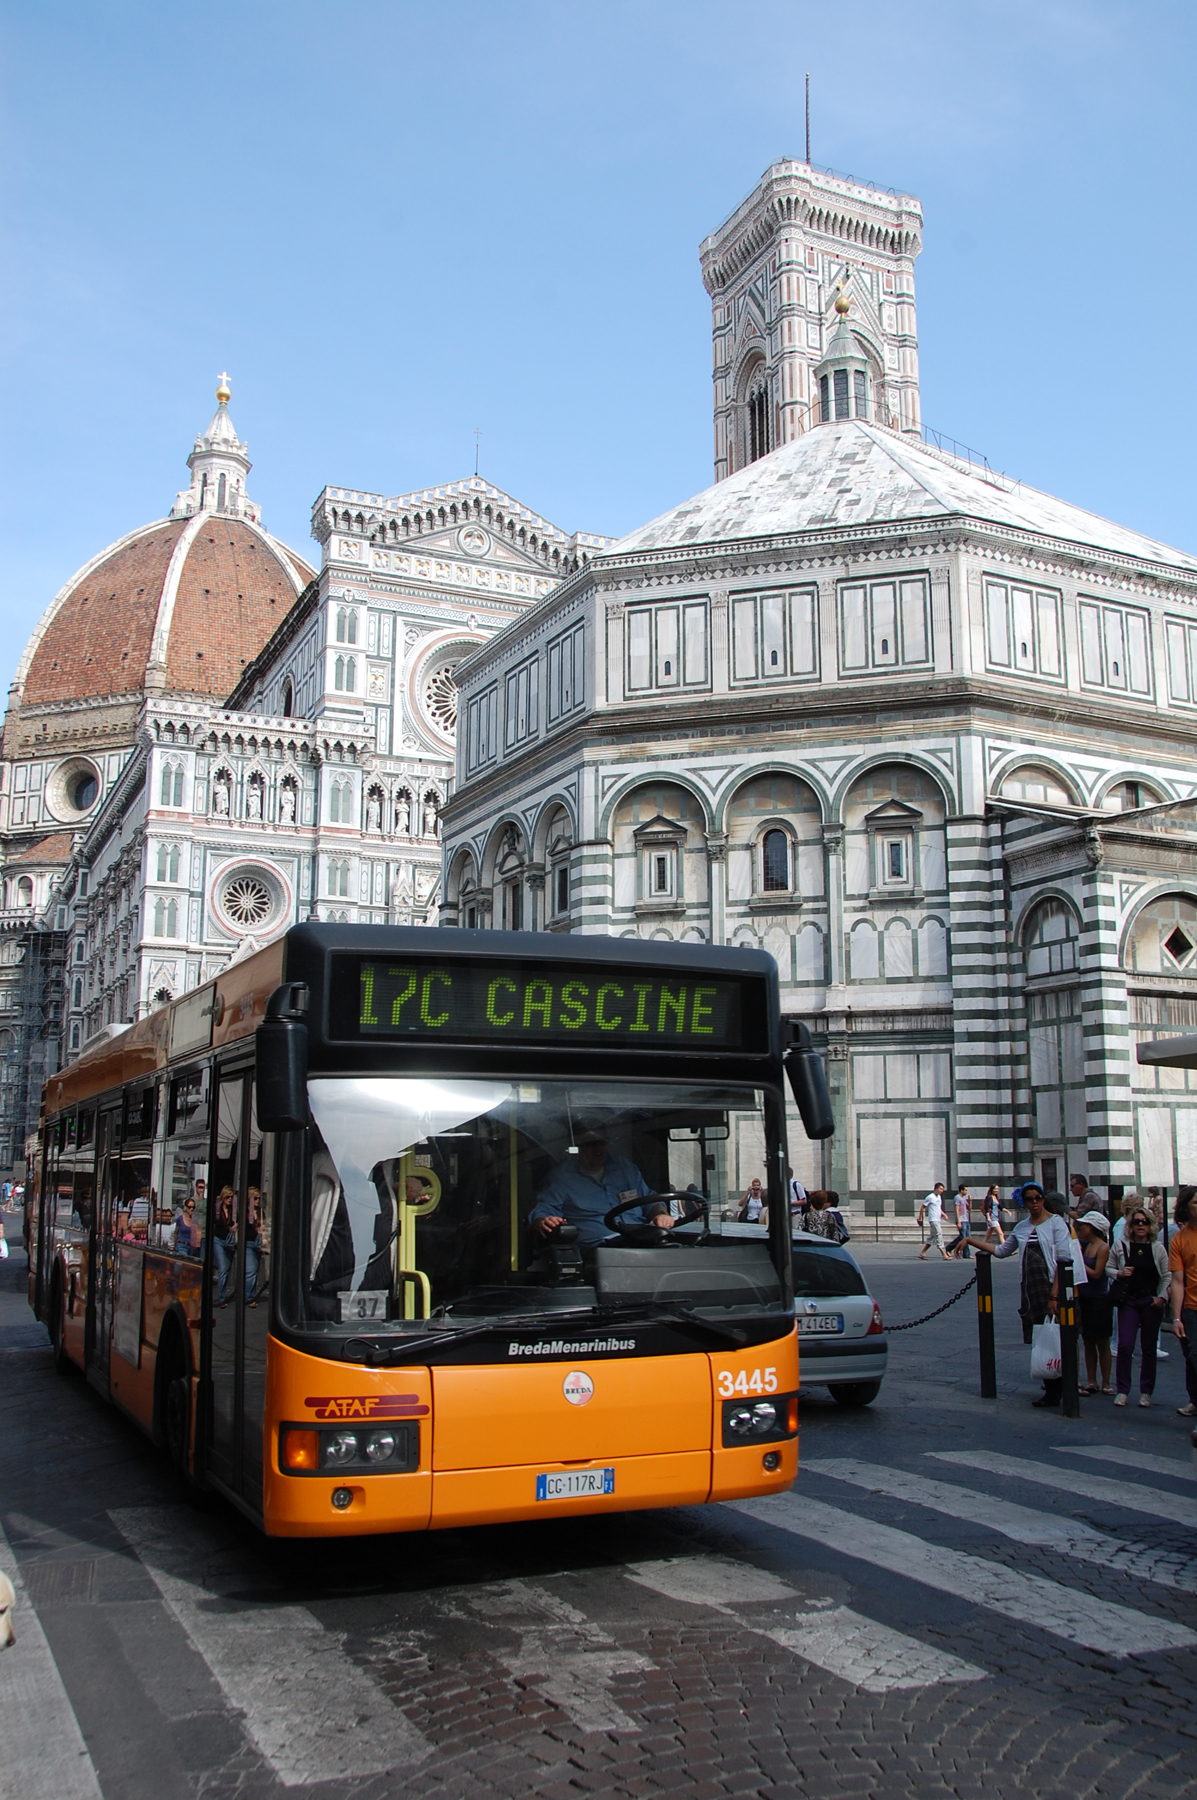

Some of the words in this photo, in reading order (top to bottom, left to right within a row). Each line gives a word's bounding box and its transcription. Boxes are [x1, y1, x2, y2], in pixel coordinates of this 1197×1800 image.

[359, 966, 452, 1027] 17C
[486, 976, 717, 1034] CASCINE
[357, 1297, 379, 1318] 37
[508, 1338, 636, 1356] BredaMenarinibus
[565, 1387, 592, 1395] BREDA
[717, 1367, 778, 1397] 3445
[324, 1398, 380, 1417] ATAF
